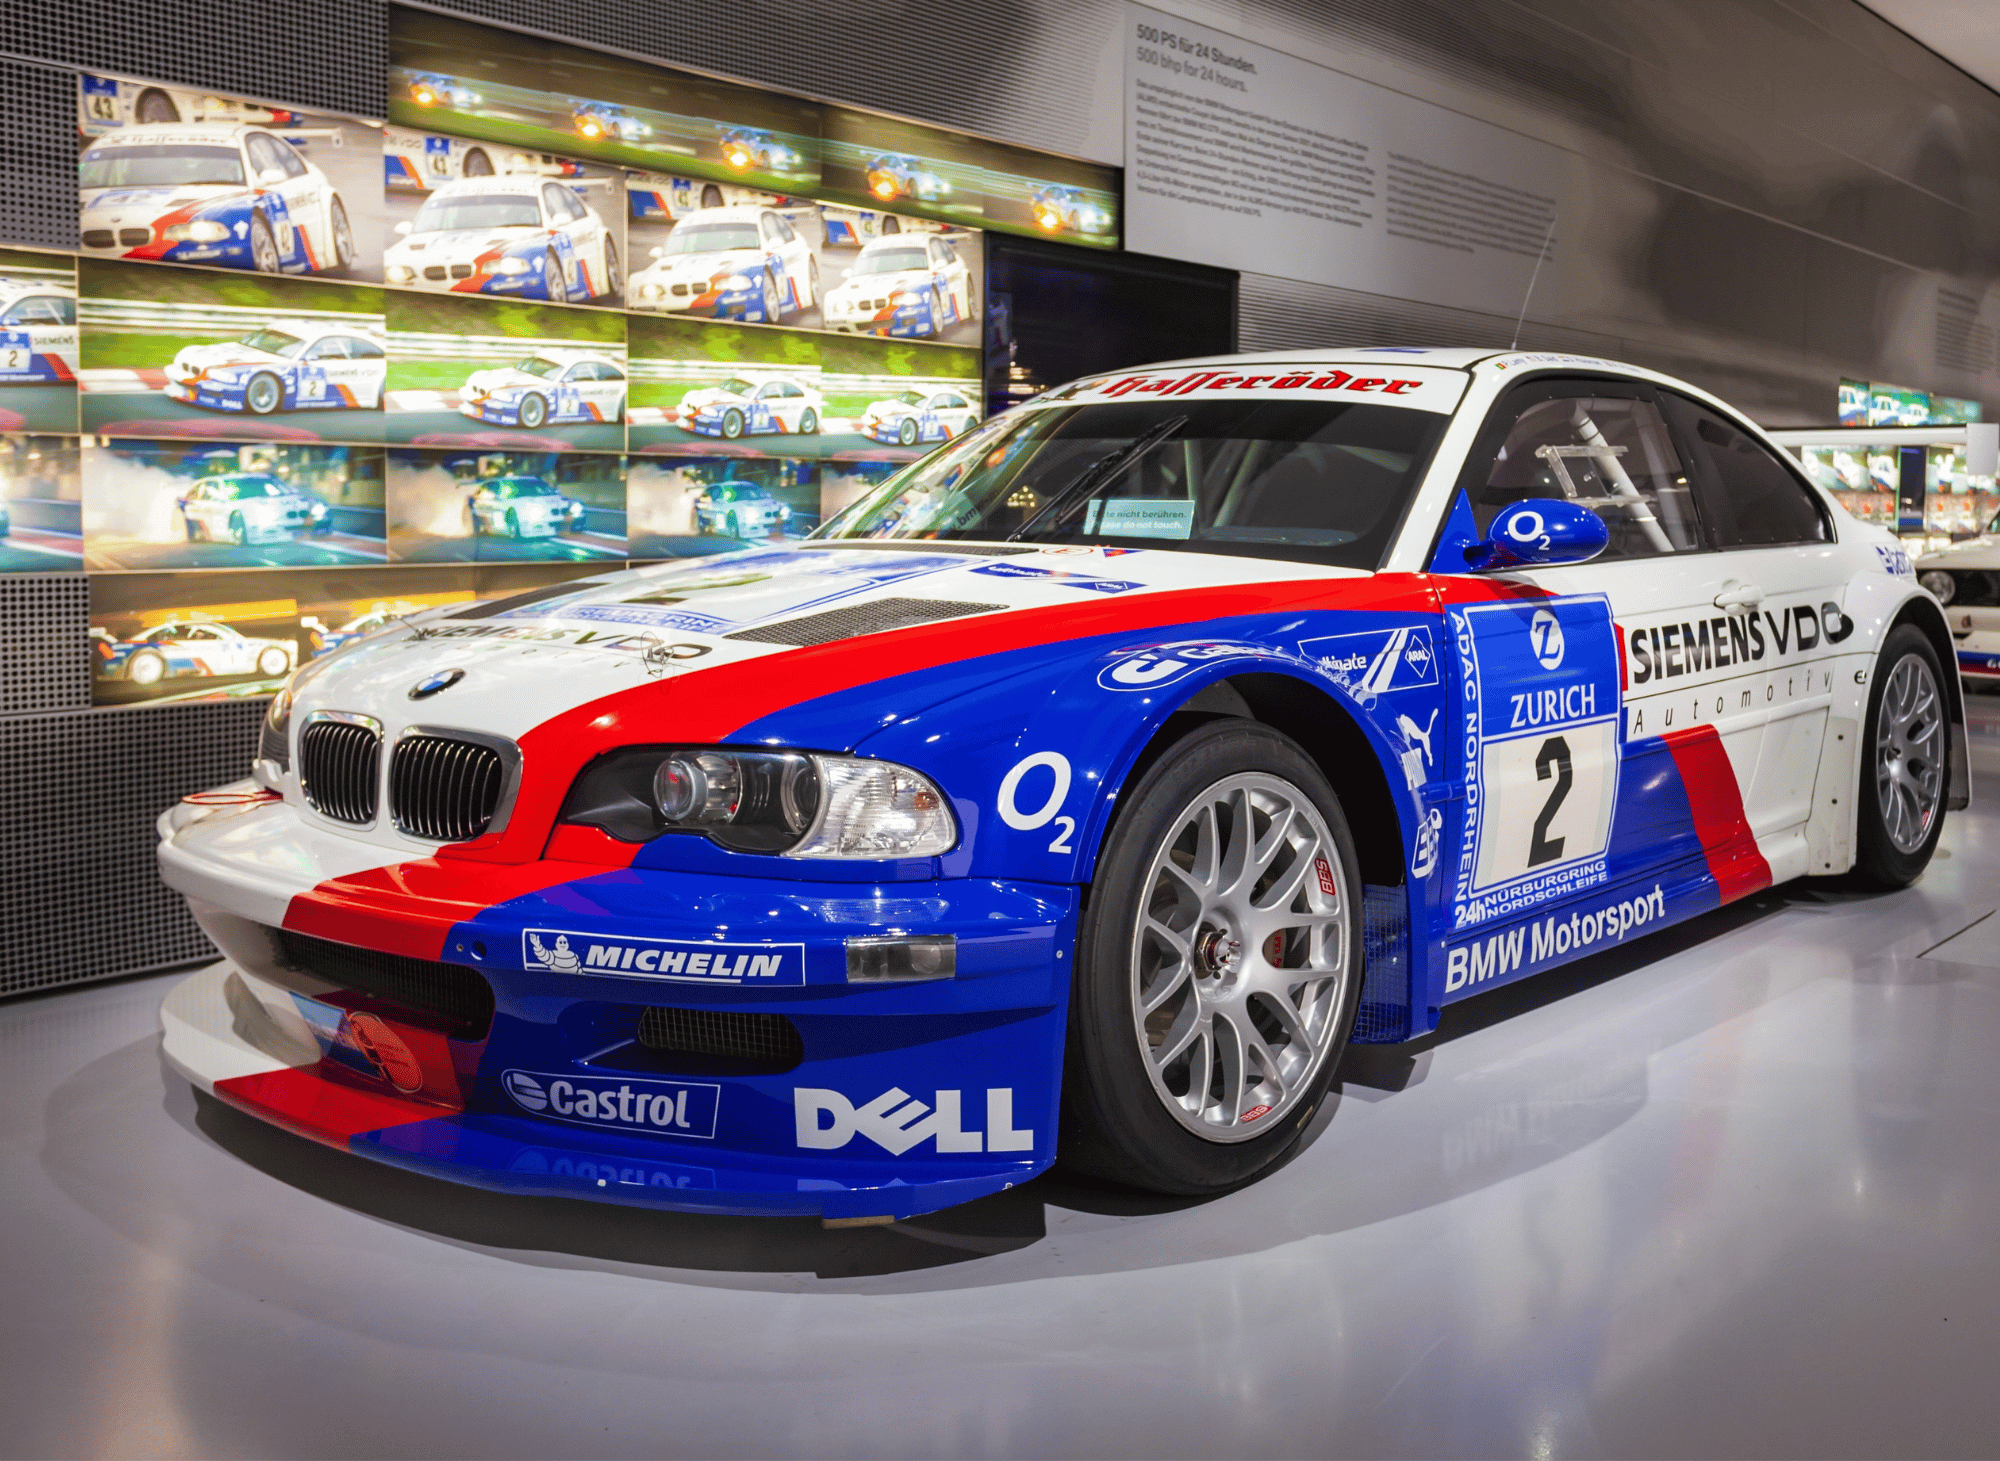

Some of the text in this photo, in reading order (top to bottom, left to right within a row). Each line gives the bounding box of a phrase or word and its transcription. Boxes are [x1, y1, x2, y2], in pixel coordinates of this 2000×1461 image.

[1137, 24, 1158, 43] 500
[1161, 31, 1177, 49] PS
[1195, 43, 1209, 59] 24
[1137, 46, 1158, 65] 500
[1161, 53, 1181, 75] bhp
[1184, 60, 1199, 77] for
[1200, 66, 1213, 81] 24
[9, 350, 18, 367] 2
[1408, 650, 1428, 662] ARAL
[1631, 611, 1765, 684] SIEMENS
[1510, 683, 1595, 728] ZURICH
[1450, 611, 1478, 902] ADAC NORDRHEIN
[1527, 736, 1573, 868] 2
[1315, 859, 1334, 894] BBS
[1485, 860, 1606, 906] NÜRBURGRING
[1486, 871, 1608, 919] NORDSCHLEIFE
[1455, 901, 1486, 929] 24h
[585, 944, 783, 977] MICHELIN
[1445, 884, 1665, 993] BMW Motorsport
[550, 1080, 691, 1128] Castrol
[794, 1087, 1034, 1156] DELL
